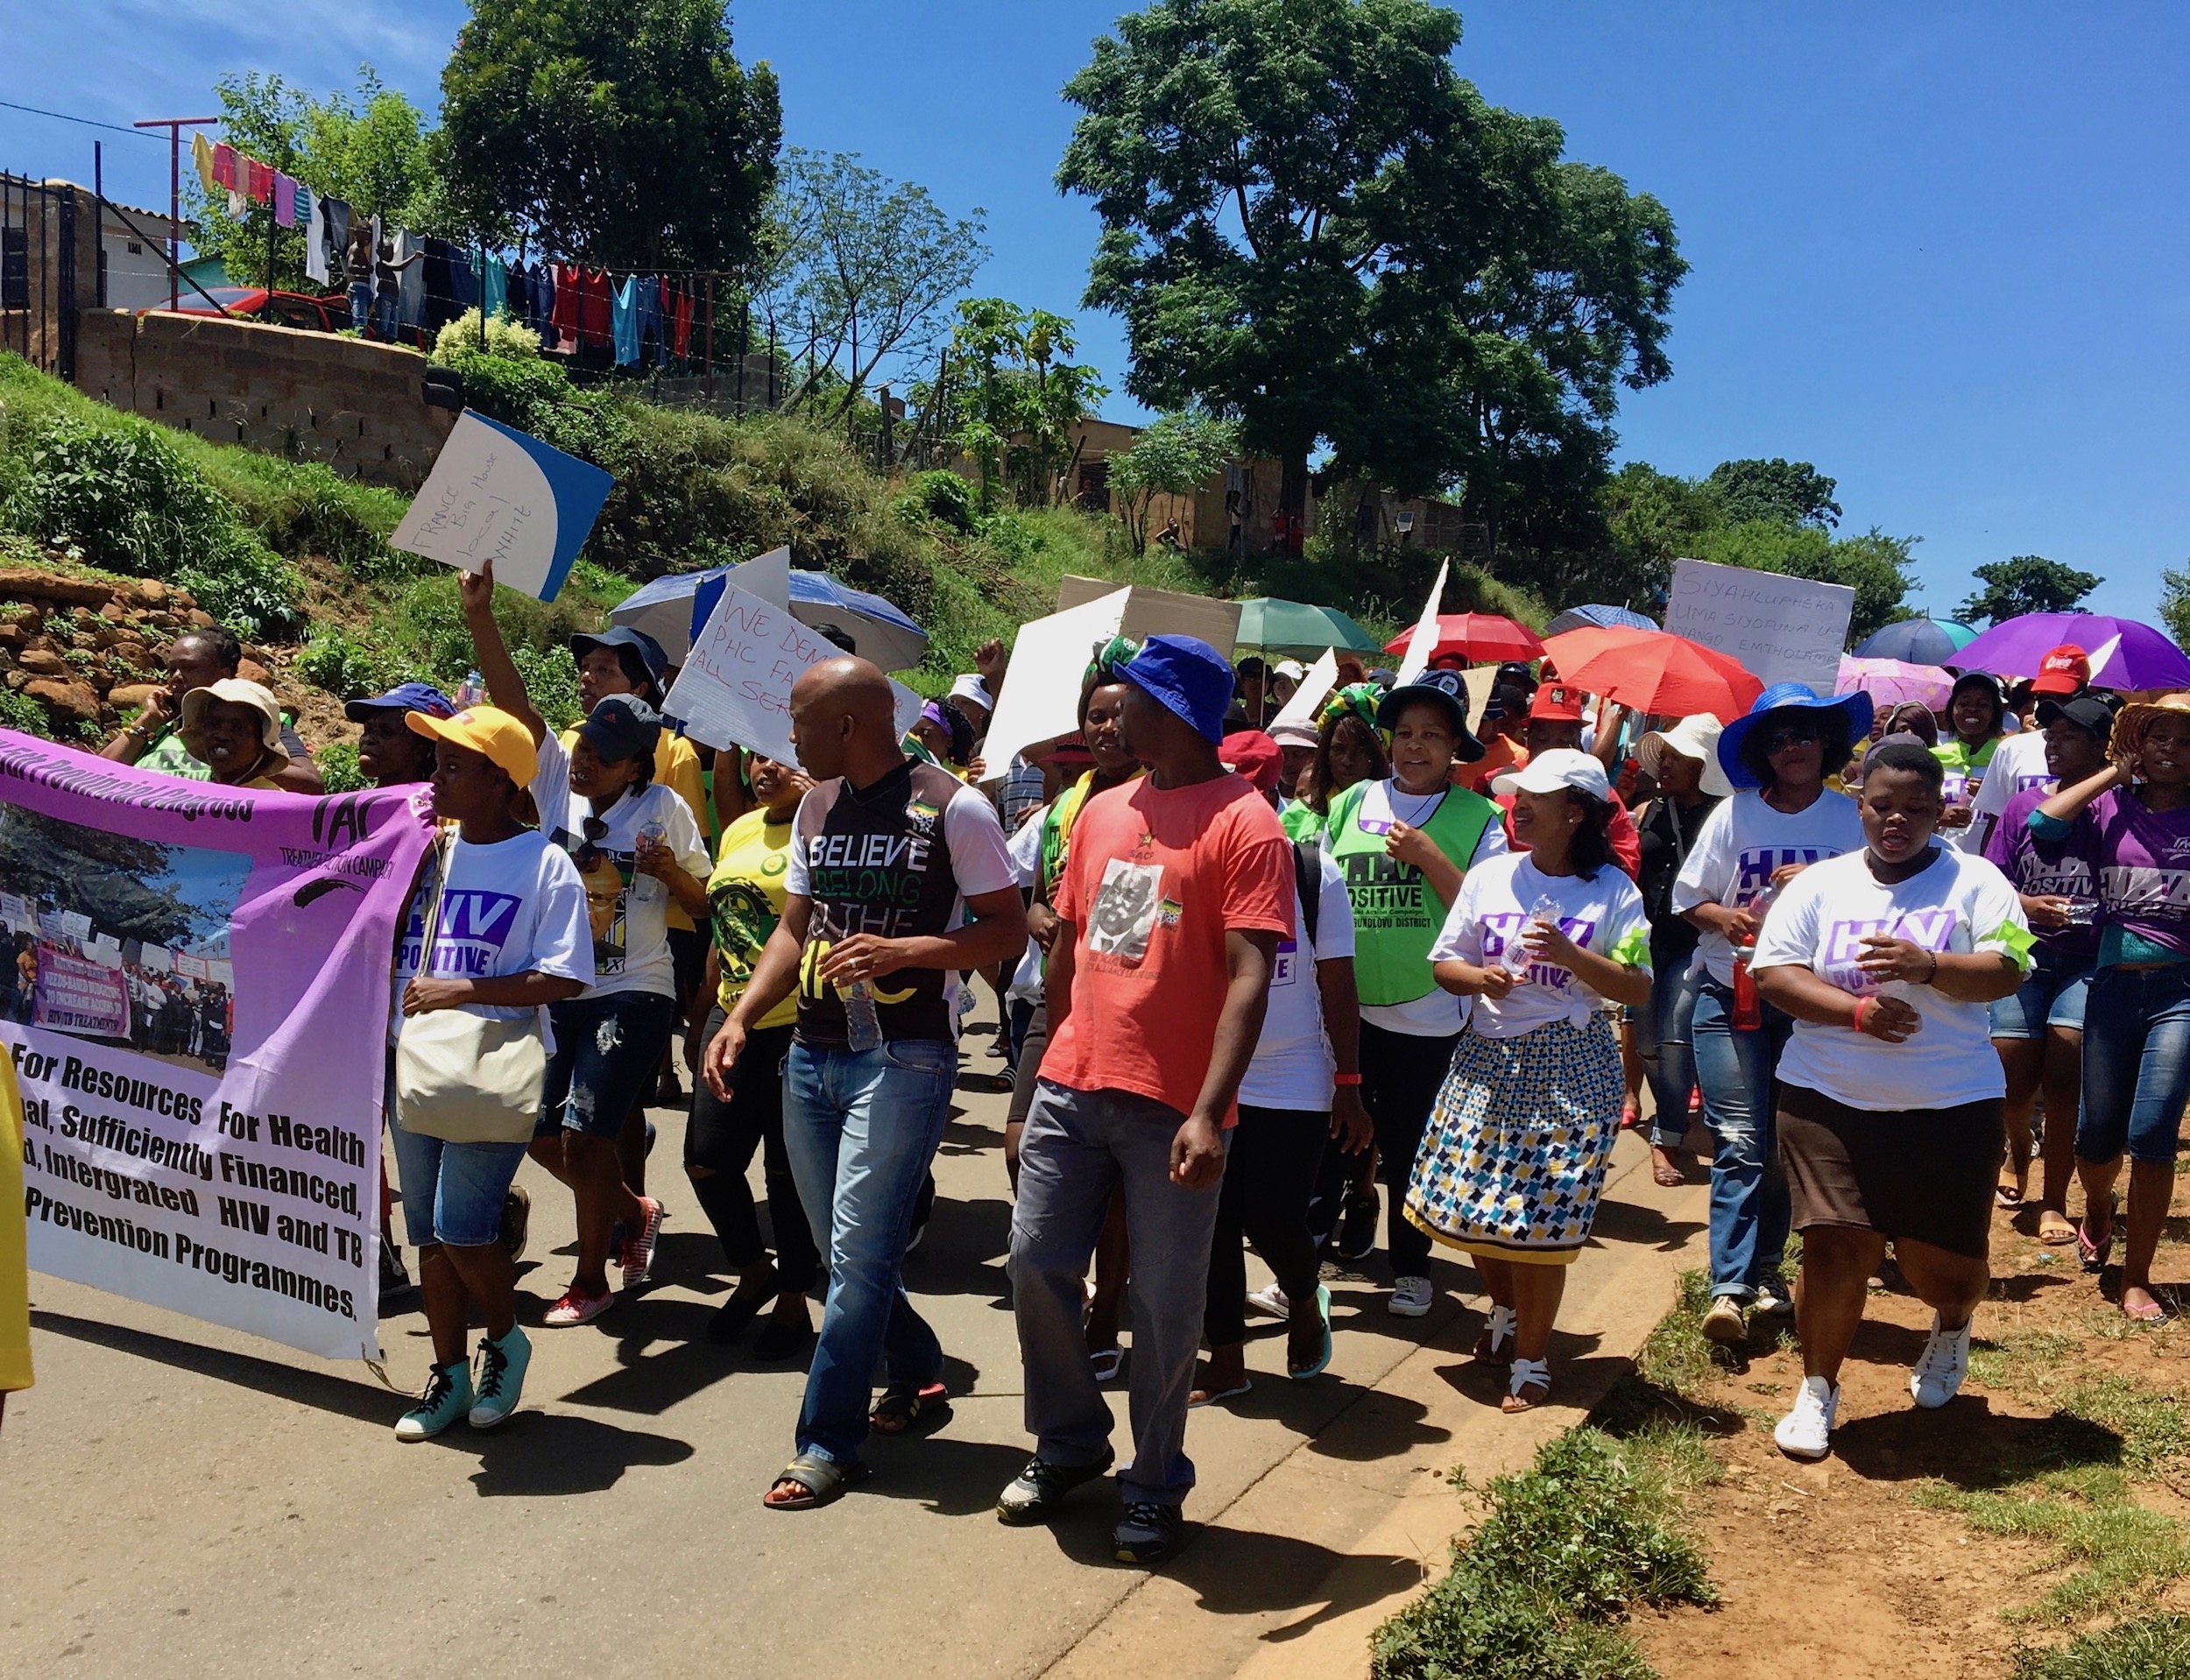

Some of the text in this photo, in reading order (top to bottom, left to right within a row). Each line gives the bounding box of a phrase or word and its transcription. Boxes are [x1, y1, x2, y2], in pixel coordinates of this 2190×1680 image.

[724, 591, 771, 637] WE
[1676, 604, 1717, 624] UMA
[1678, 571, 1834, 612] SIYAHLUPHEKA
[712, 625, 757, 664] PHC
[29, 759, 170, 806] Provincial
[1395, 918, 1431, 928] DISTRICT
[11, 1043, 365, 1169] For Resources For Health
[60, 1105, 214, 1182] Sufficiently
[219, 1152, 362, 1221] Financed,
[25, 1186, 169, 1260] Prevention
[44, 1143, 201, 1218] Intergrated
[217, 1195, 270, 1237] HIV
[276, 1215, 328, 1255] and
[334, 1226, 364, 1269] TB
